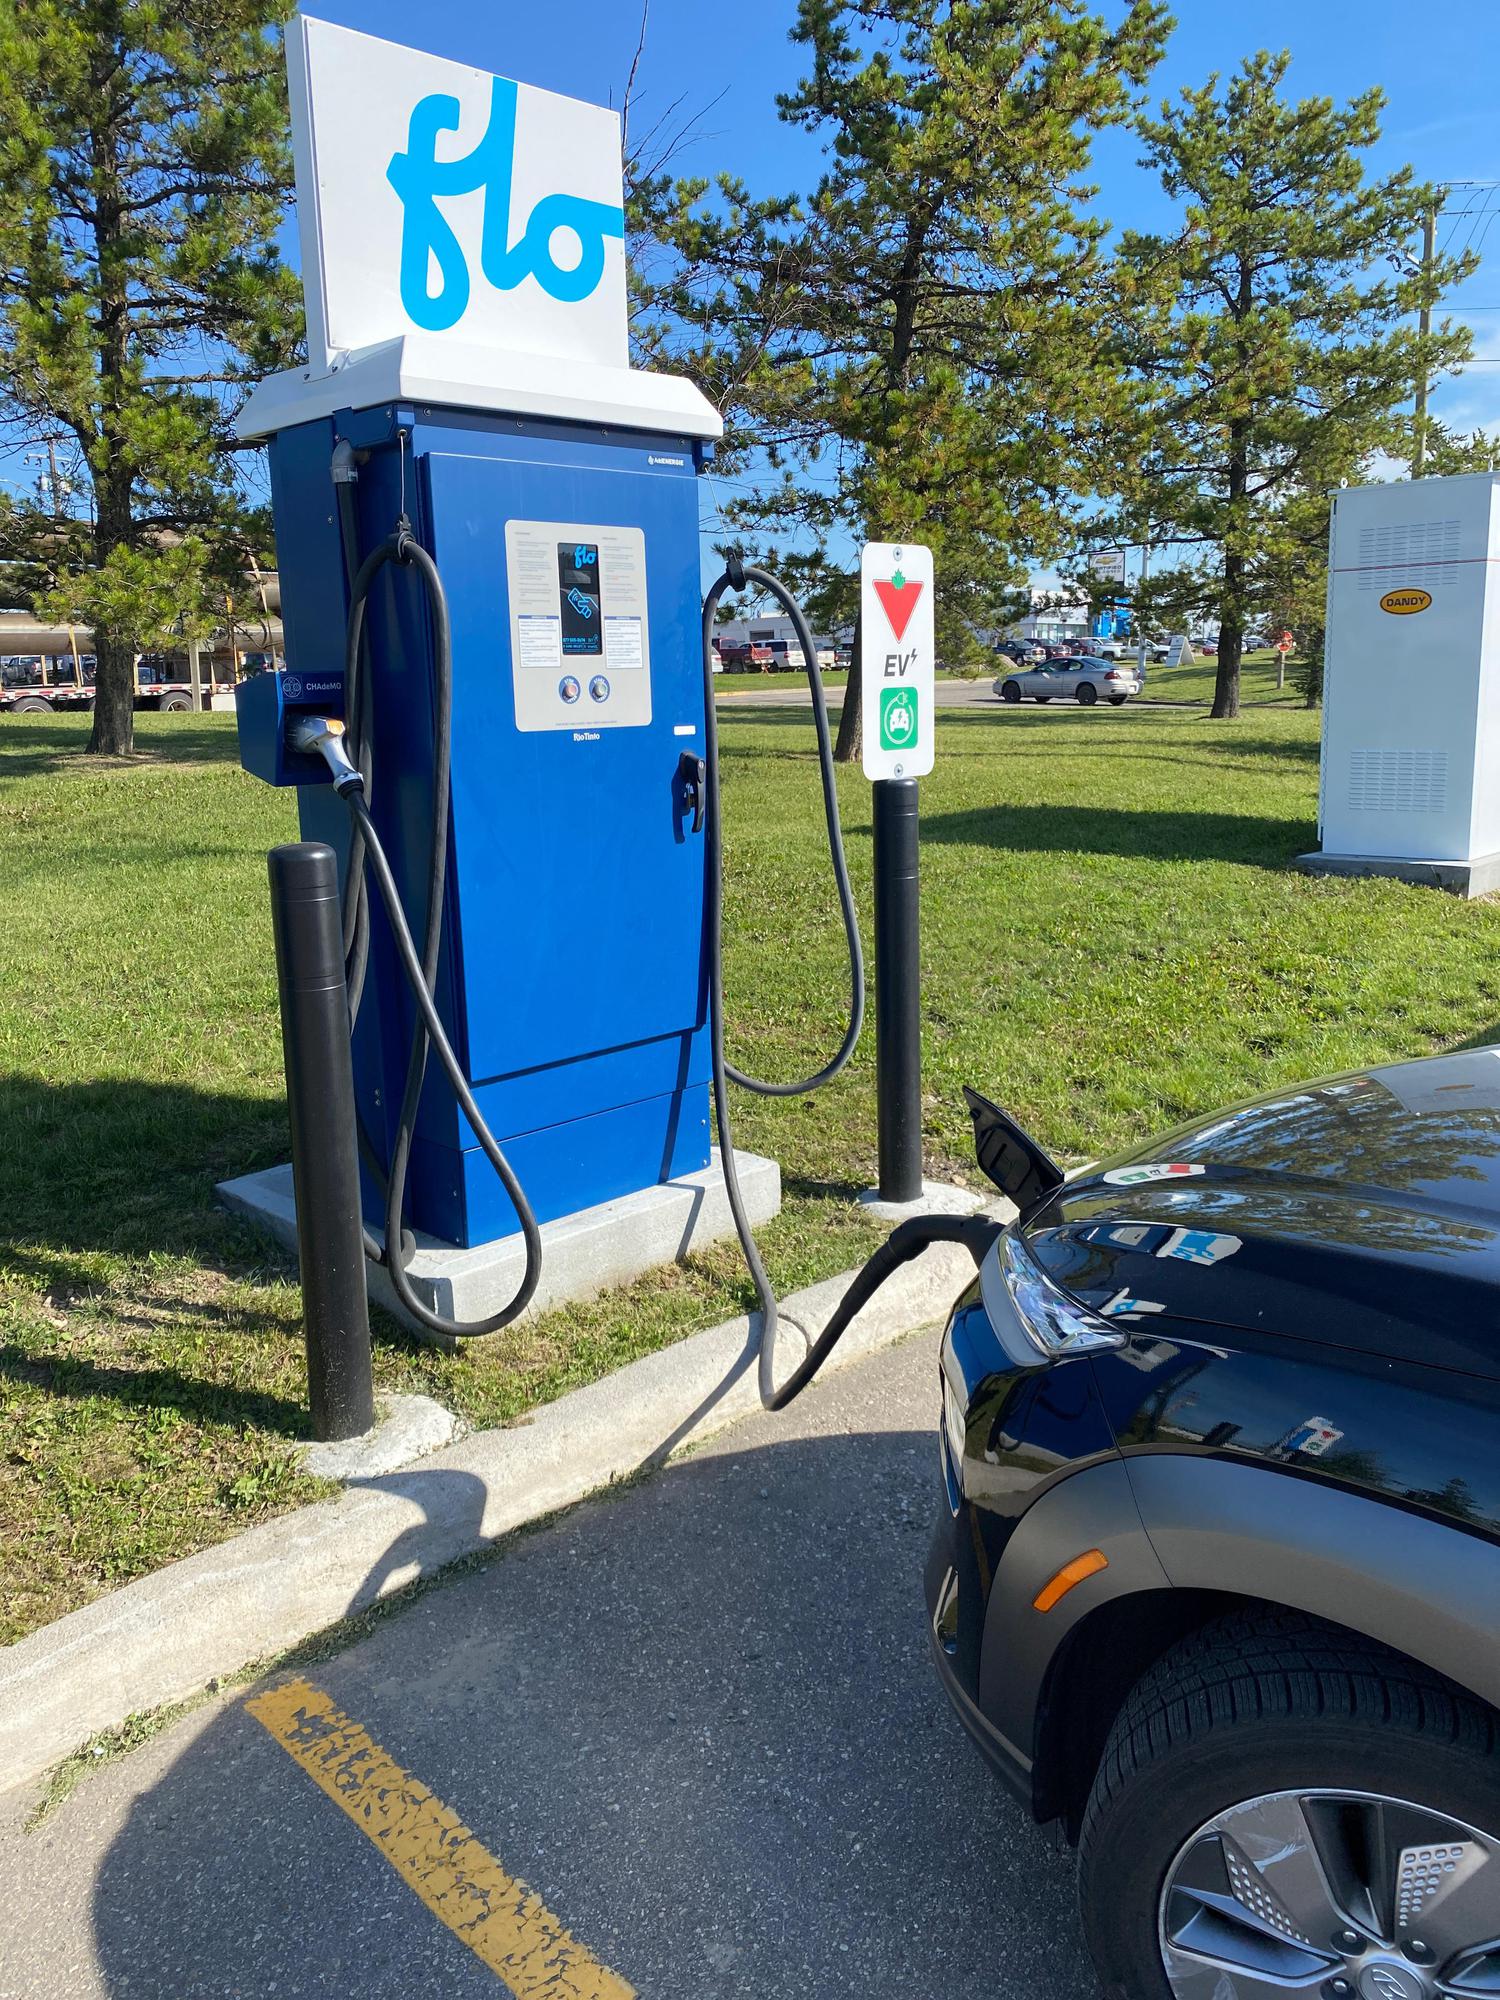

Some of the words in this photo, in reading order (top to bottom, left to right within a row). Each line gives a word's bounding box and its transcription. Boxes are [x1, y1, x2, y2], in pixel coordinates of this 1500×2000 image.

[386, 76, 624, 331] flo
[575, 545, 596, 569] flo
[1386, 597, 1426, 607] DANDY
[884, 654, 910, 677] EV
[306, 682, 342, 691] CHAdeMO
